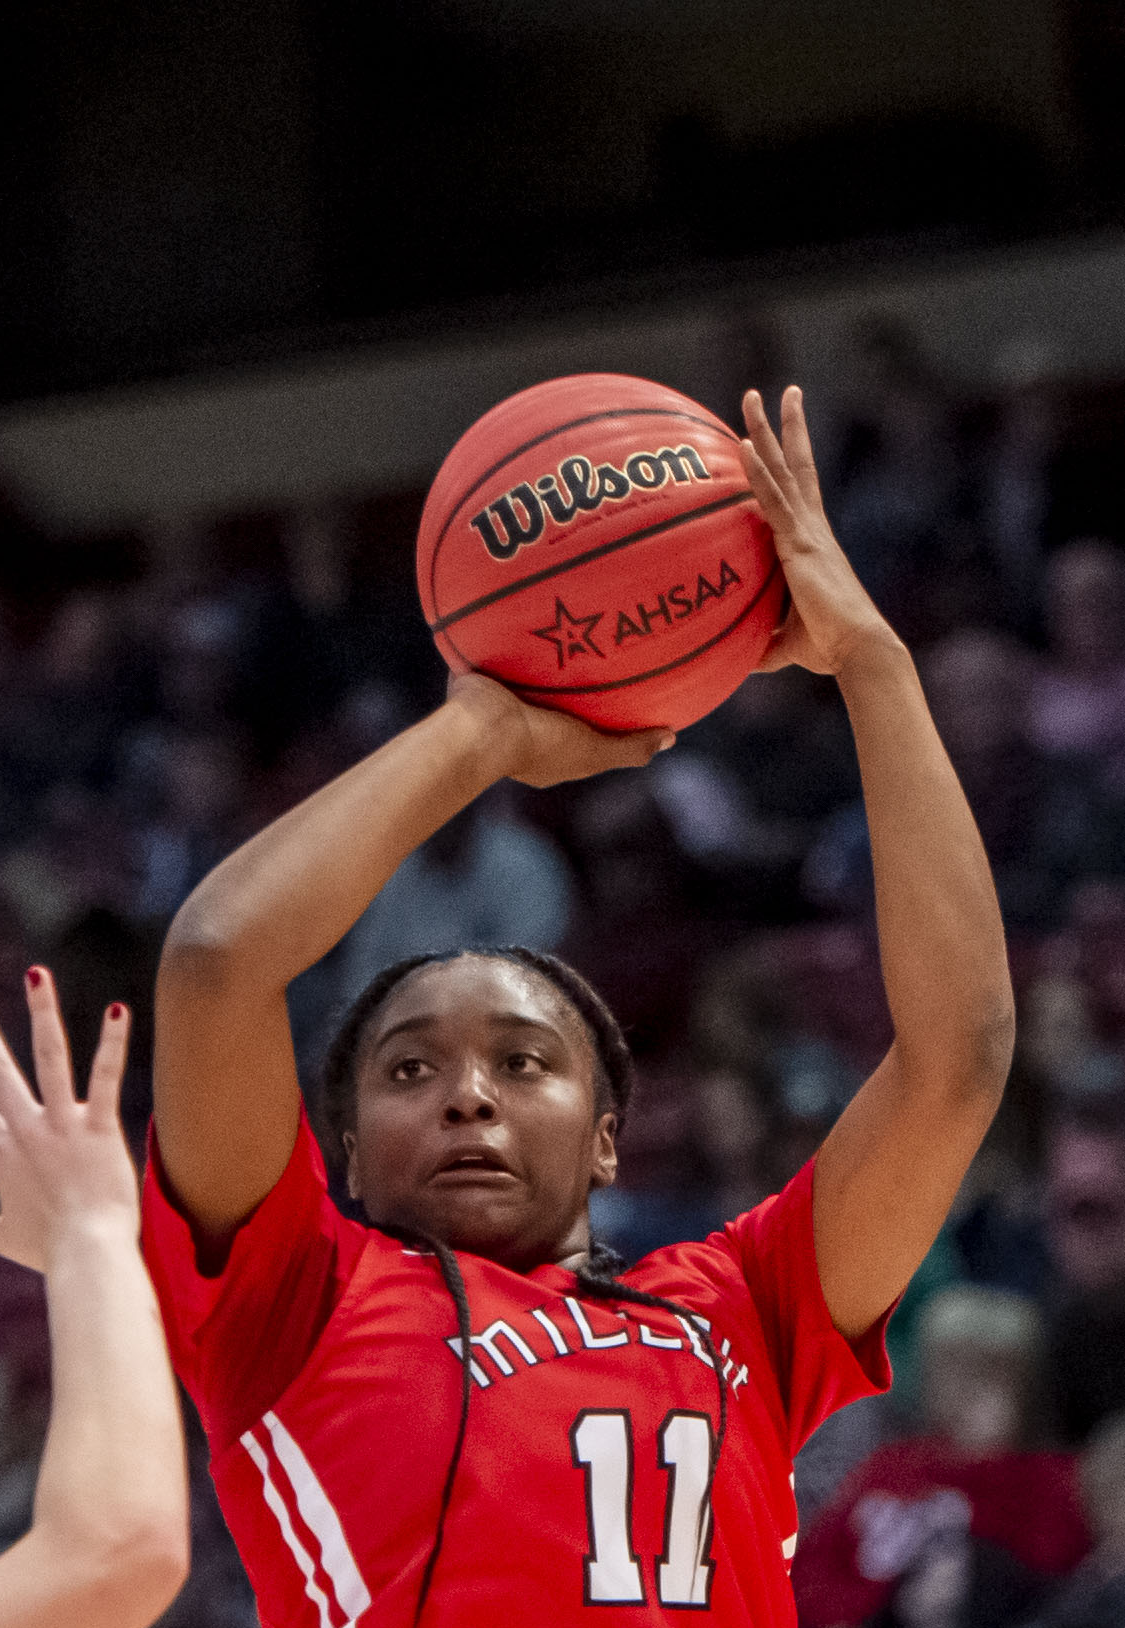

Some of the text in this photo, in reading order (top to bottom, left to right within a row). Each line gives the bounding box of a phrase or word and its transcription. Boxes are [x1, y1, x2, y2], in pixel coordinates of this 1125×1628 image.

[470, 443, 712, 562] Wilson
[614, 559, 743, 645] AHSAA
[569, 1407, 717, 1611] 11
